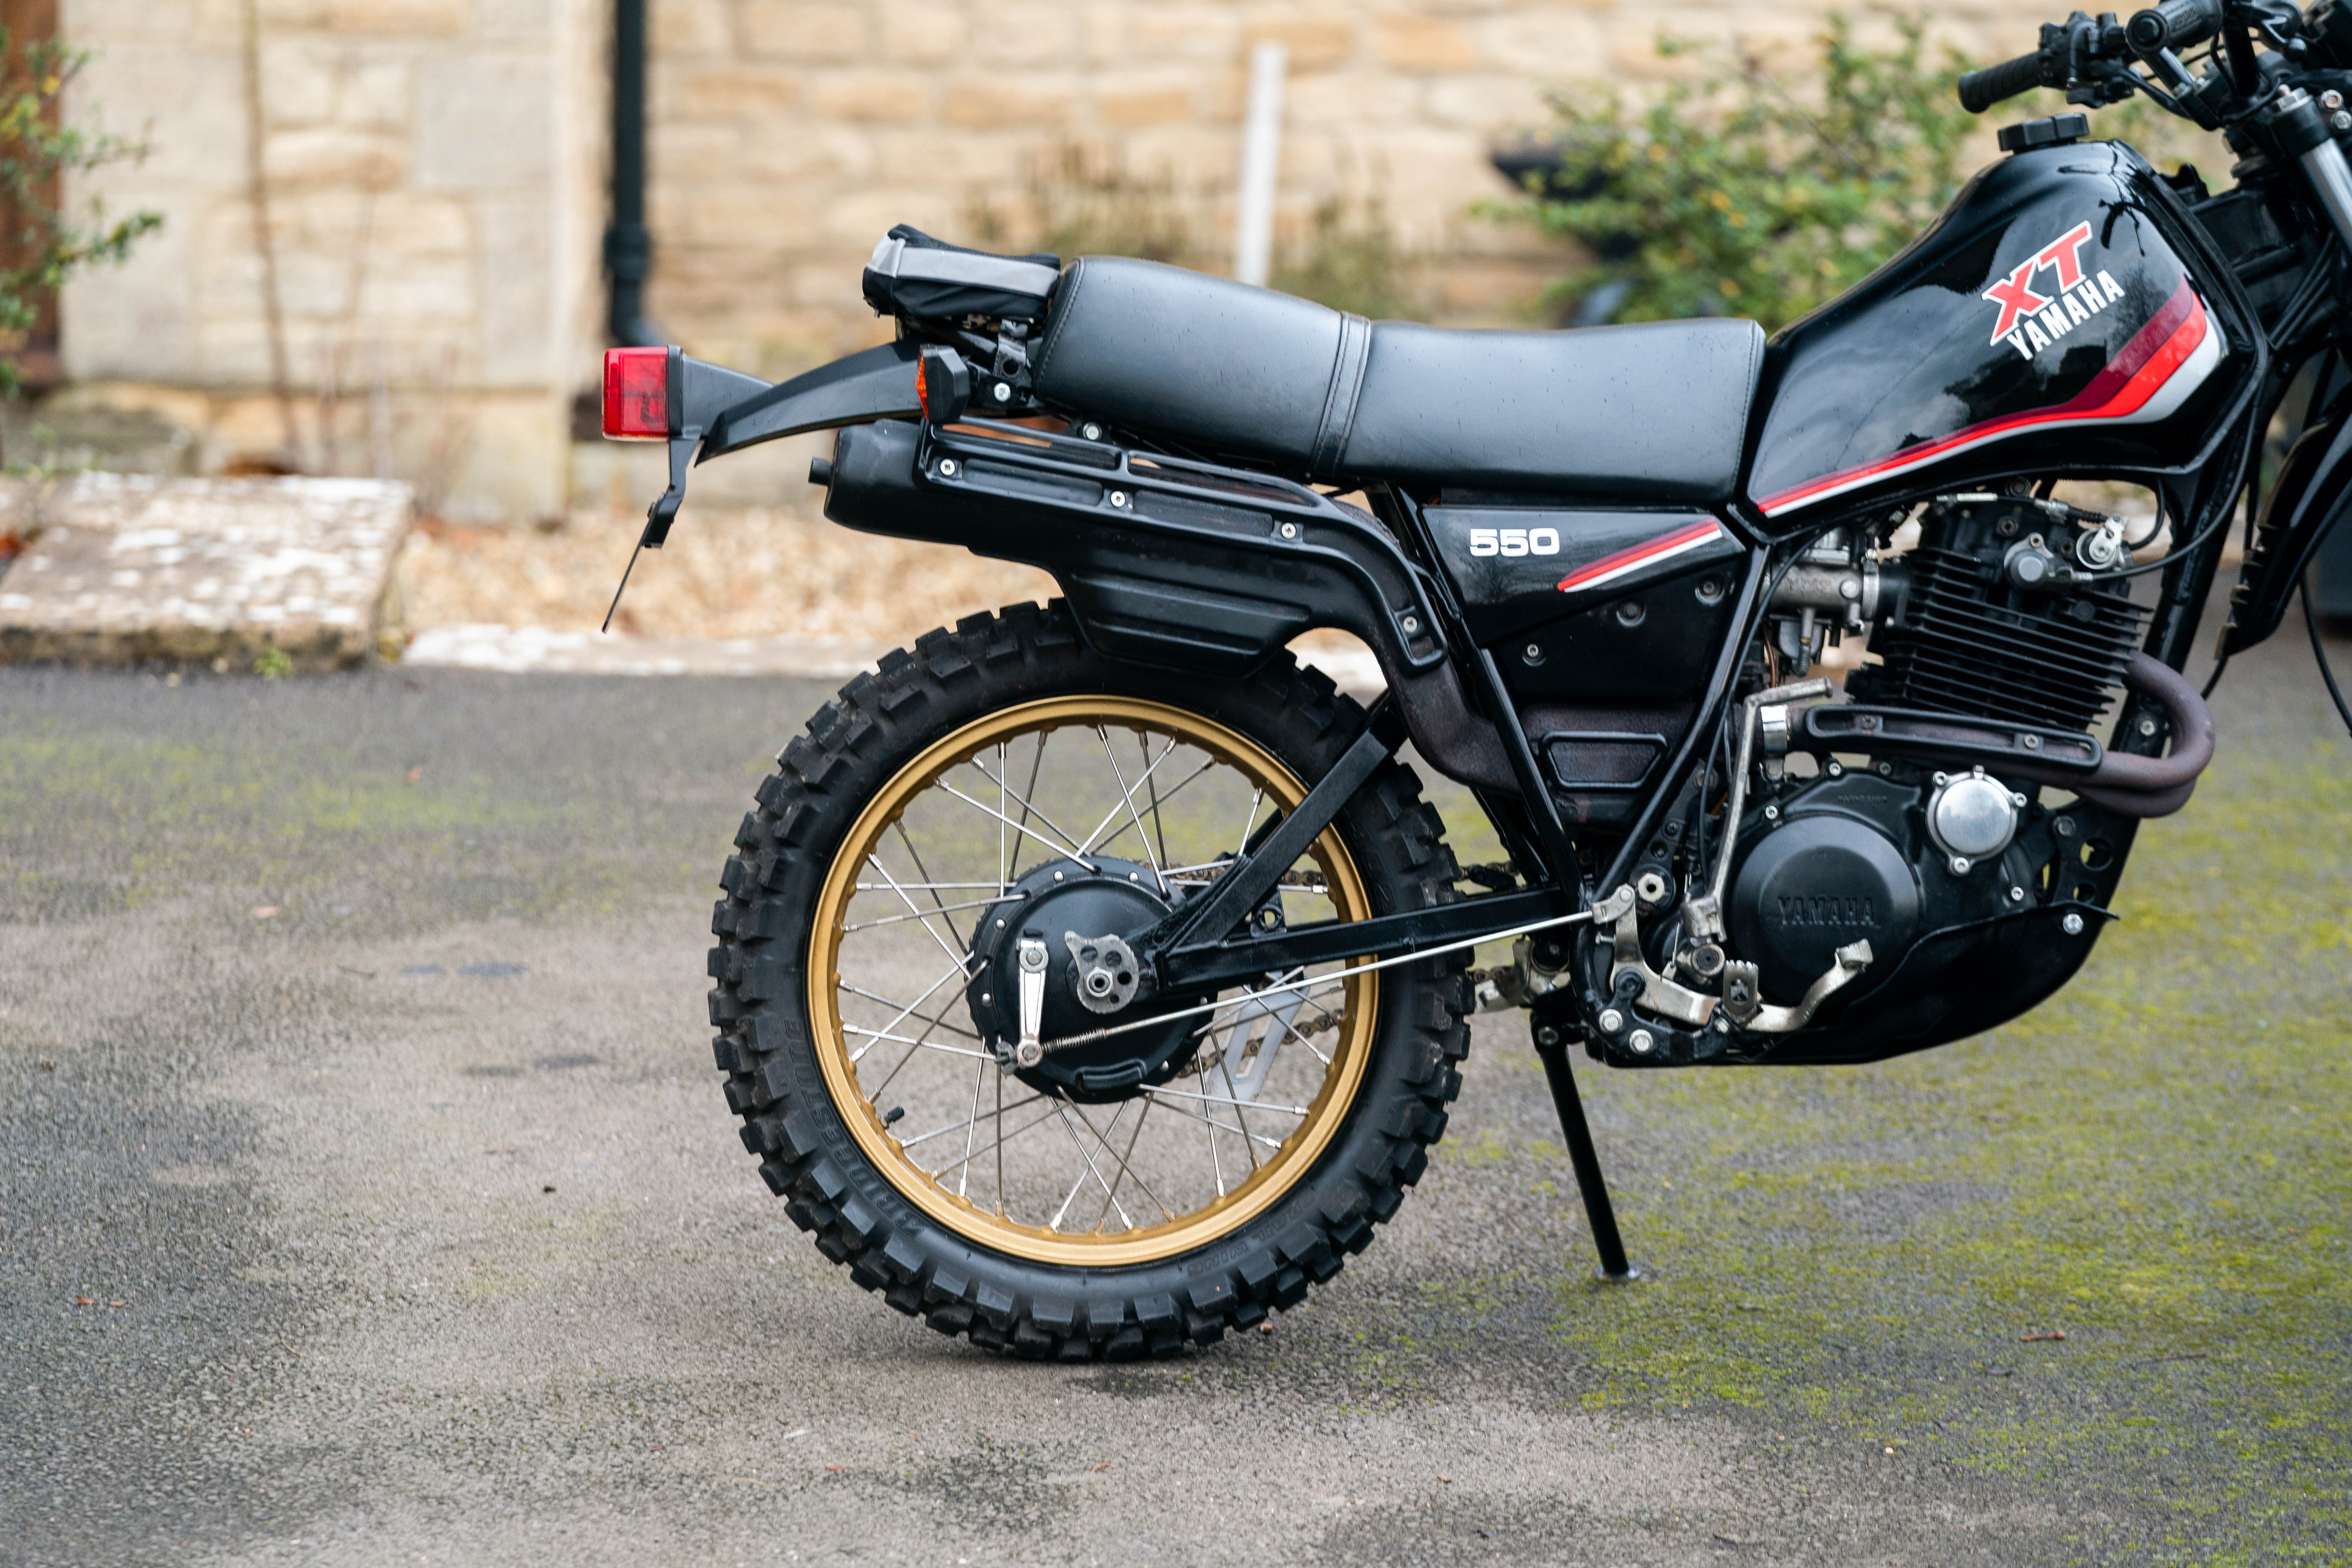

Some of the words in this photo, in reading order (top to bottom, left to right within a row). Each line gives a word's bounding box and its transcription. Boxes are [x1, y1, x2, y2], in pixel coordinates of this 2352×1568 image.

[1982, 221, 2093, 347] XT
[2007, 270, 2125, 360] YAMAHA
[1470, 528, 1560, 557] 550
[1778, 897, 1874, 926] YAMAHA
[783, 1018, 925, 1235] BRIDGESTONE
[1186, 1240, 1251, 1277] WING
